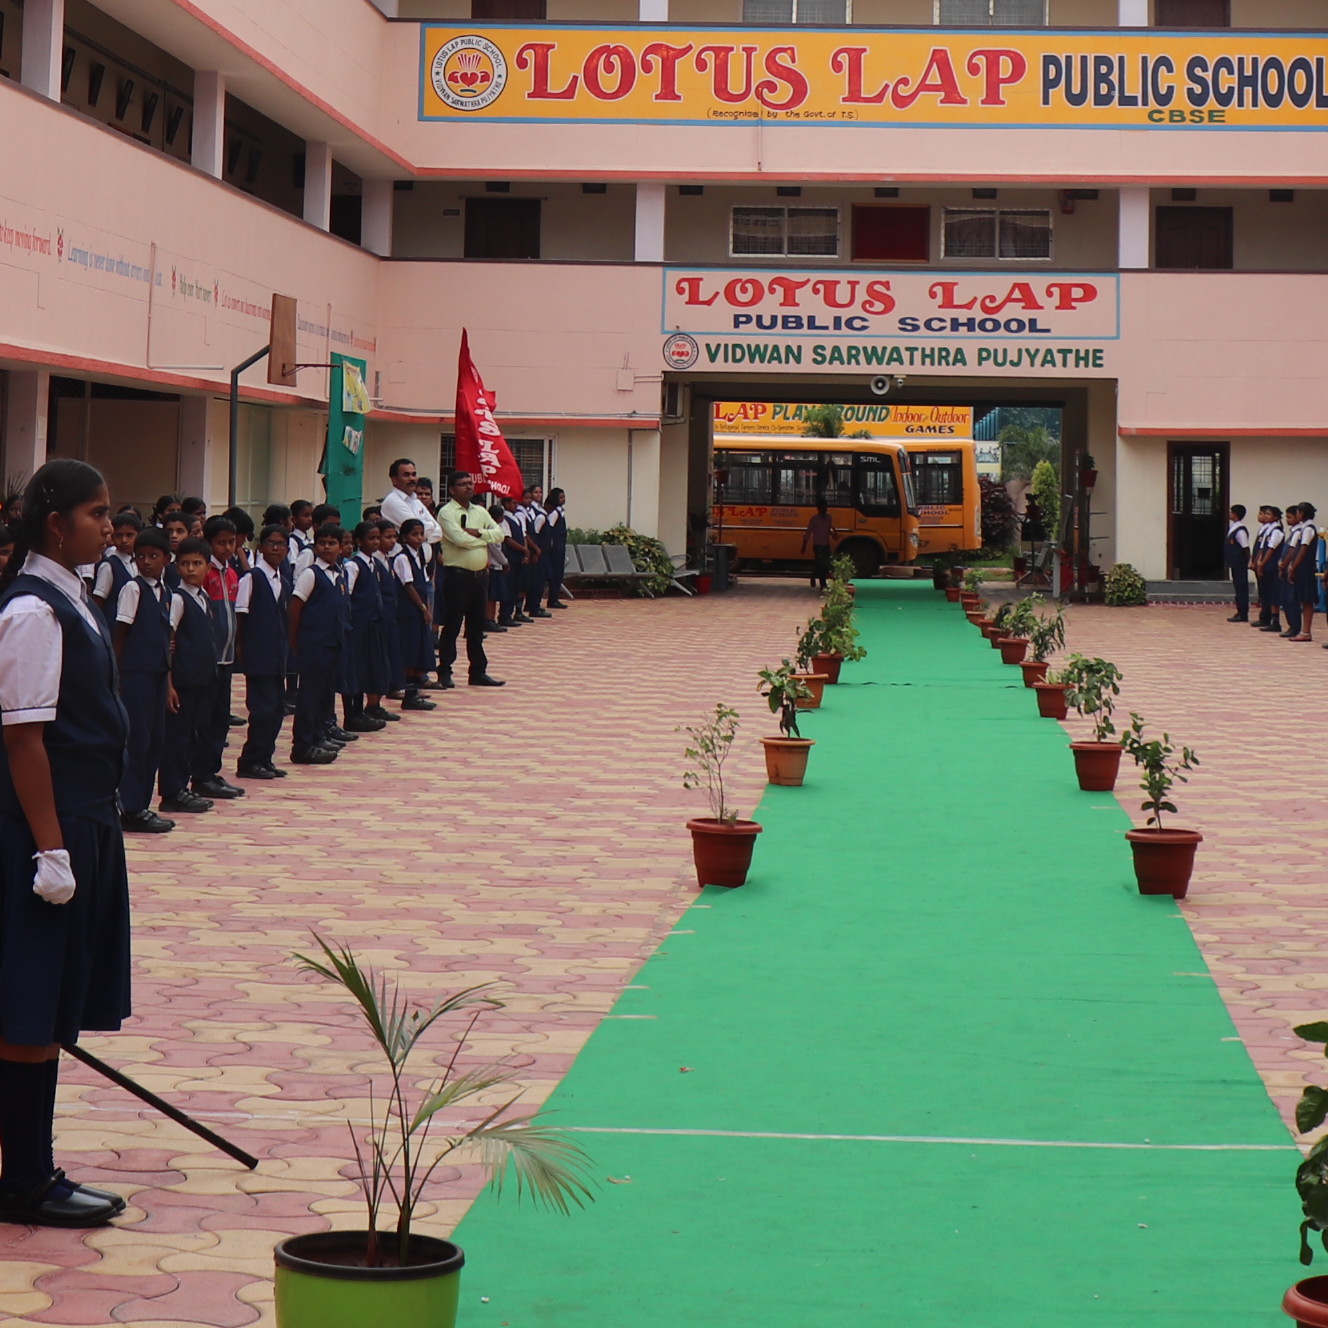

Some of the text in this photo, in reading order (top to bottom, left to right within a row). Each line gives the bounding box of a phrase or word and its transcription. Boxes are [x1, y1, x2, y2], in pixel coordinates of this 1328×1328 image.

[515, 42, 810, 111] LOTUS
[831, 46, 1027, 109] LAP
[1040, 54, 1176, 108] PUBLIC
[767, 110, 778, 119] by
[785, 110, 800, 119] the
[1146, 108, 1226, 124] CBSE
[674, 276, 1098, 315] LOTUS LAP
[732, 313, 1052, 334] PUBLIC SCHOOL
[705, 343, 803, 364] VIDWAN
[811, 344, 968, 367] SARWATHRA
[976, 347, 1104, 368] PUJYATHE
[713, 402, 767, 423] LAP
[891, 405, 924, 425] Indoor
[930, 405, 971, 425] Outdoor
[905, 424, 956, 435] GAMES
[727, 507, 768, 518] LAP
